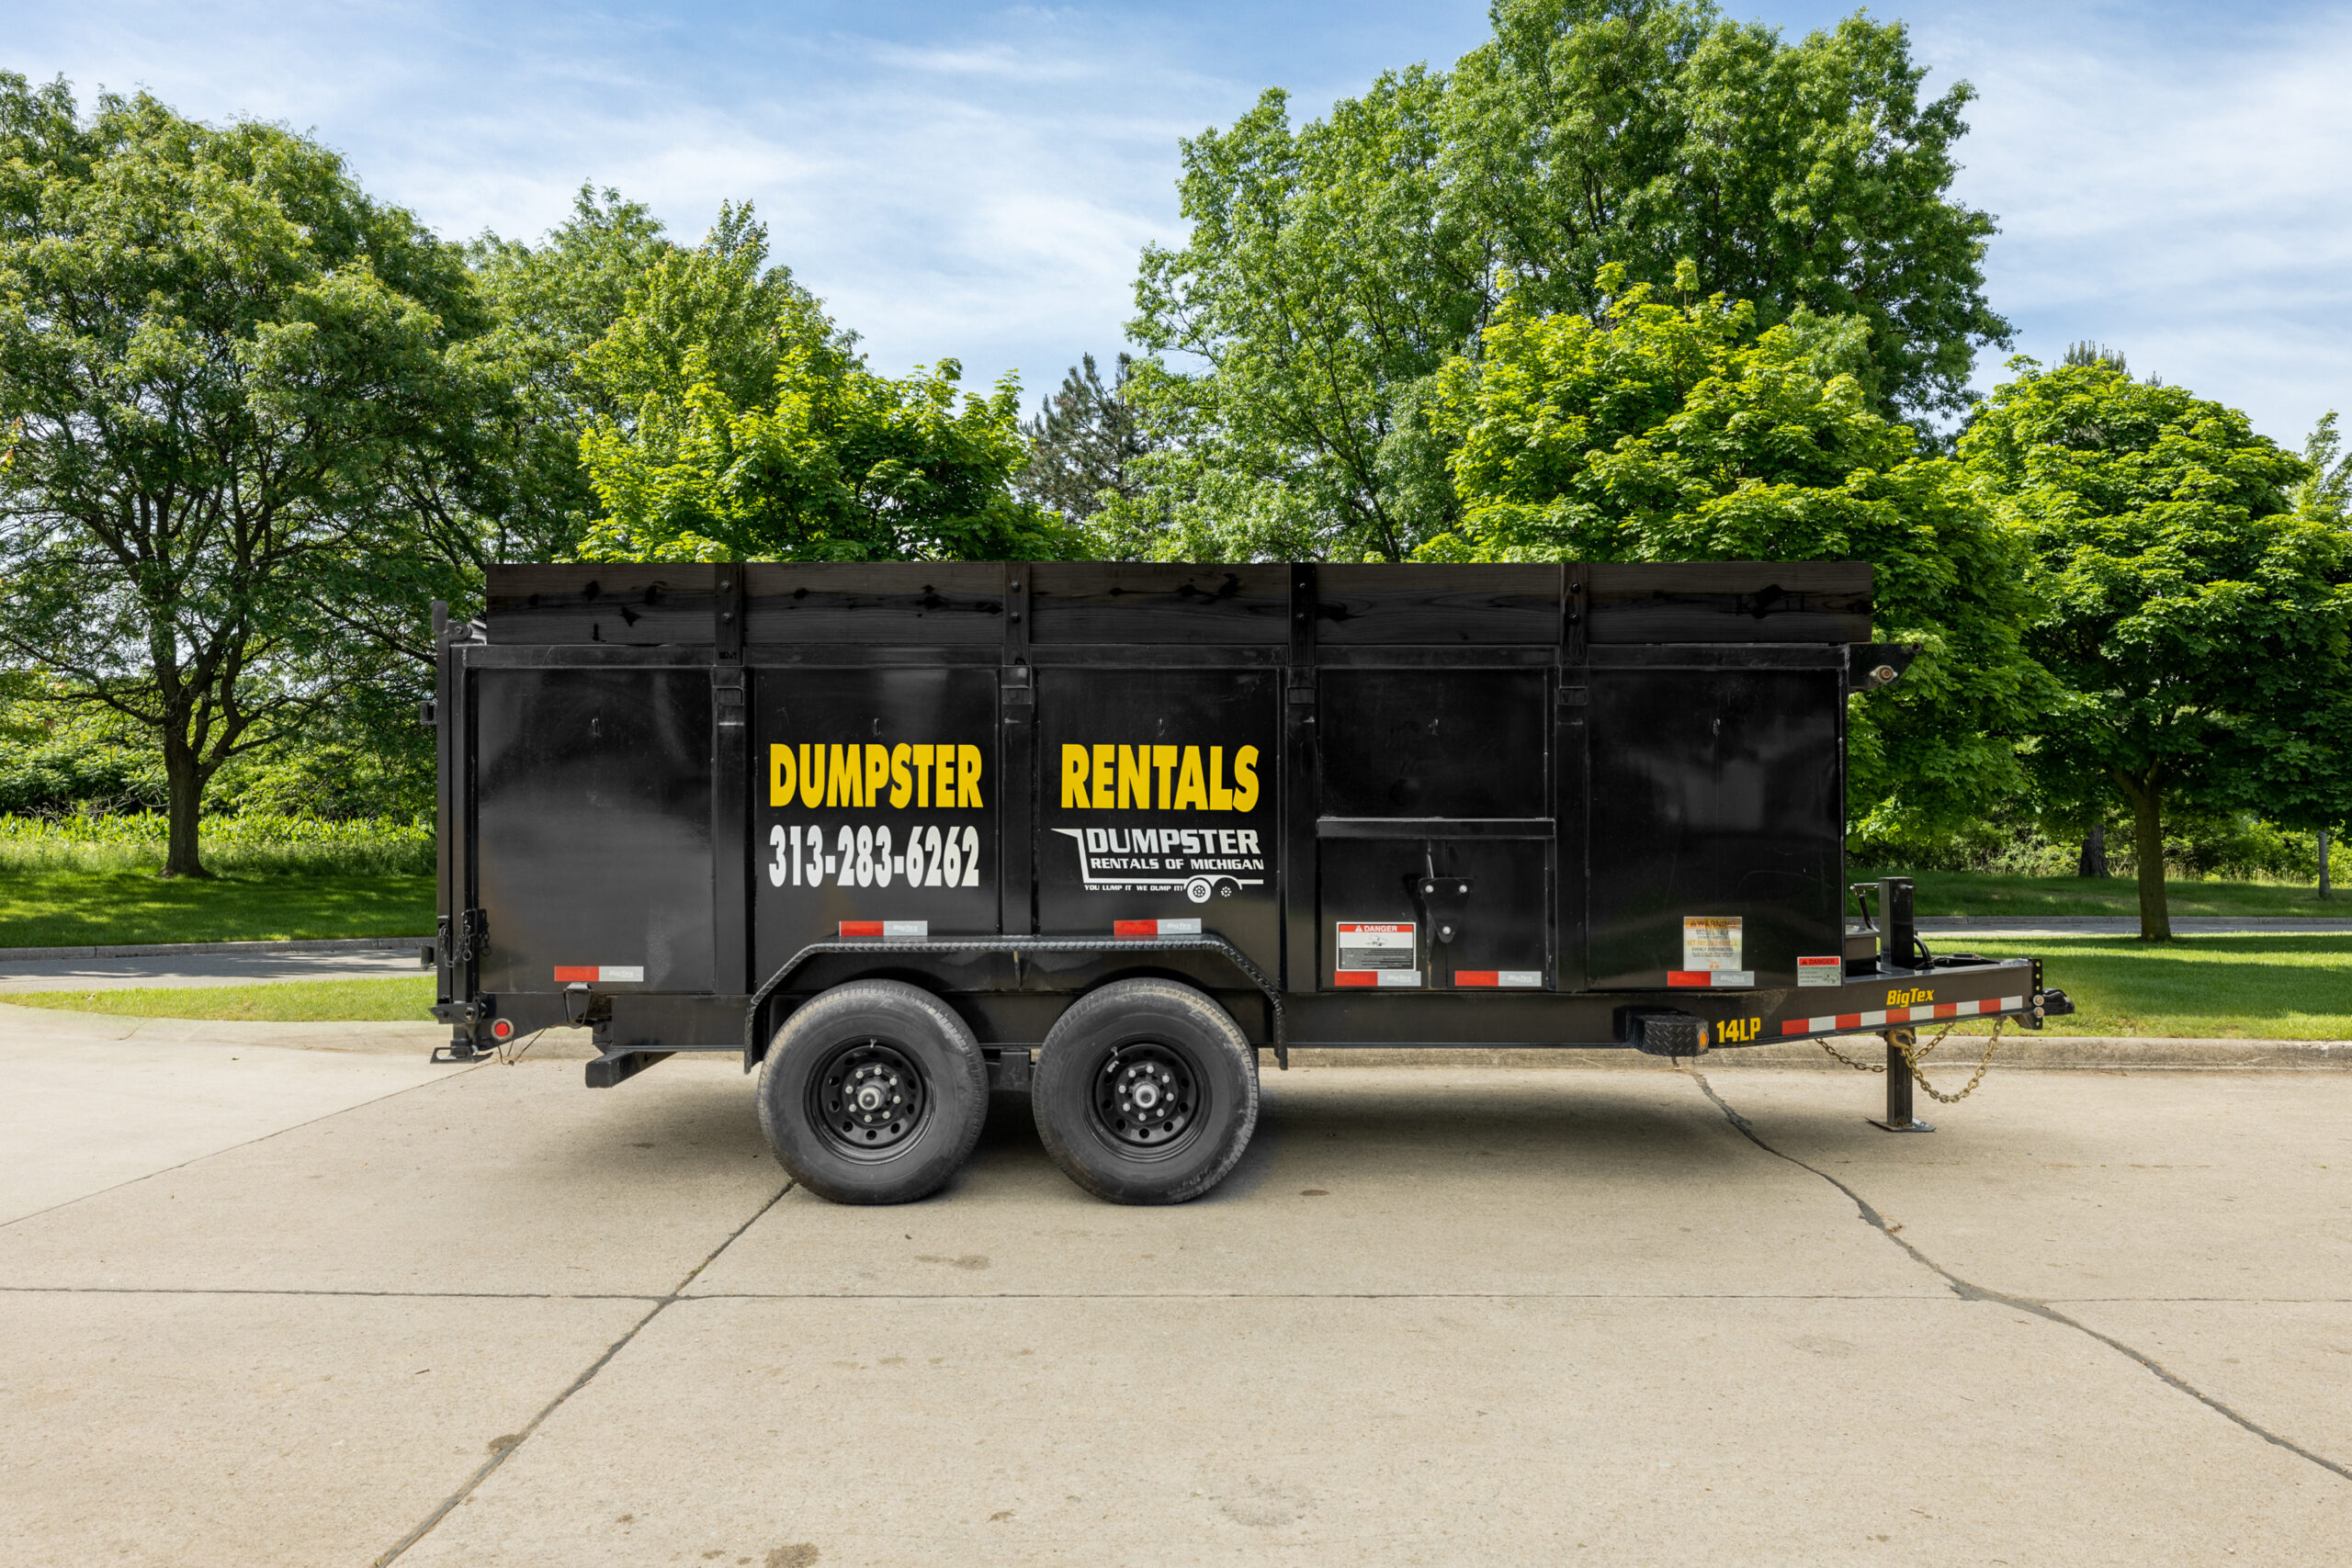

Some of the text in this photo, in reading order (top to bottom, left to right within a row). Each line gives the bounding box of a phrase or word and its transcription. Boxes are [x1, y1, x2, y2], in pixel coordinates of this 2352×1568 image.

[769, 742, 1260, 812] DUMPSTER RENTALS
[1086, 828, 1261, 854] DUMPSTER
[769, 824, 979, 888] 313-283-6262
[1091, 858, 1264, 870] RENTALS OF MICHIGAN
[1886, 987, 1935, 1008] BigTex
[1716, 1017, 1761, 1043] 14LP
